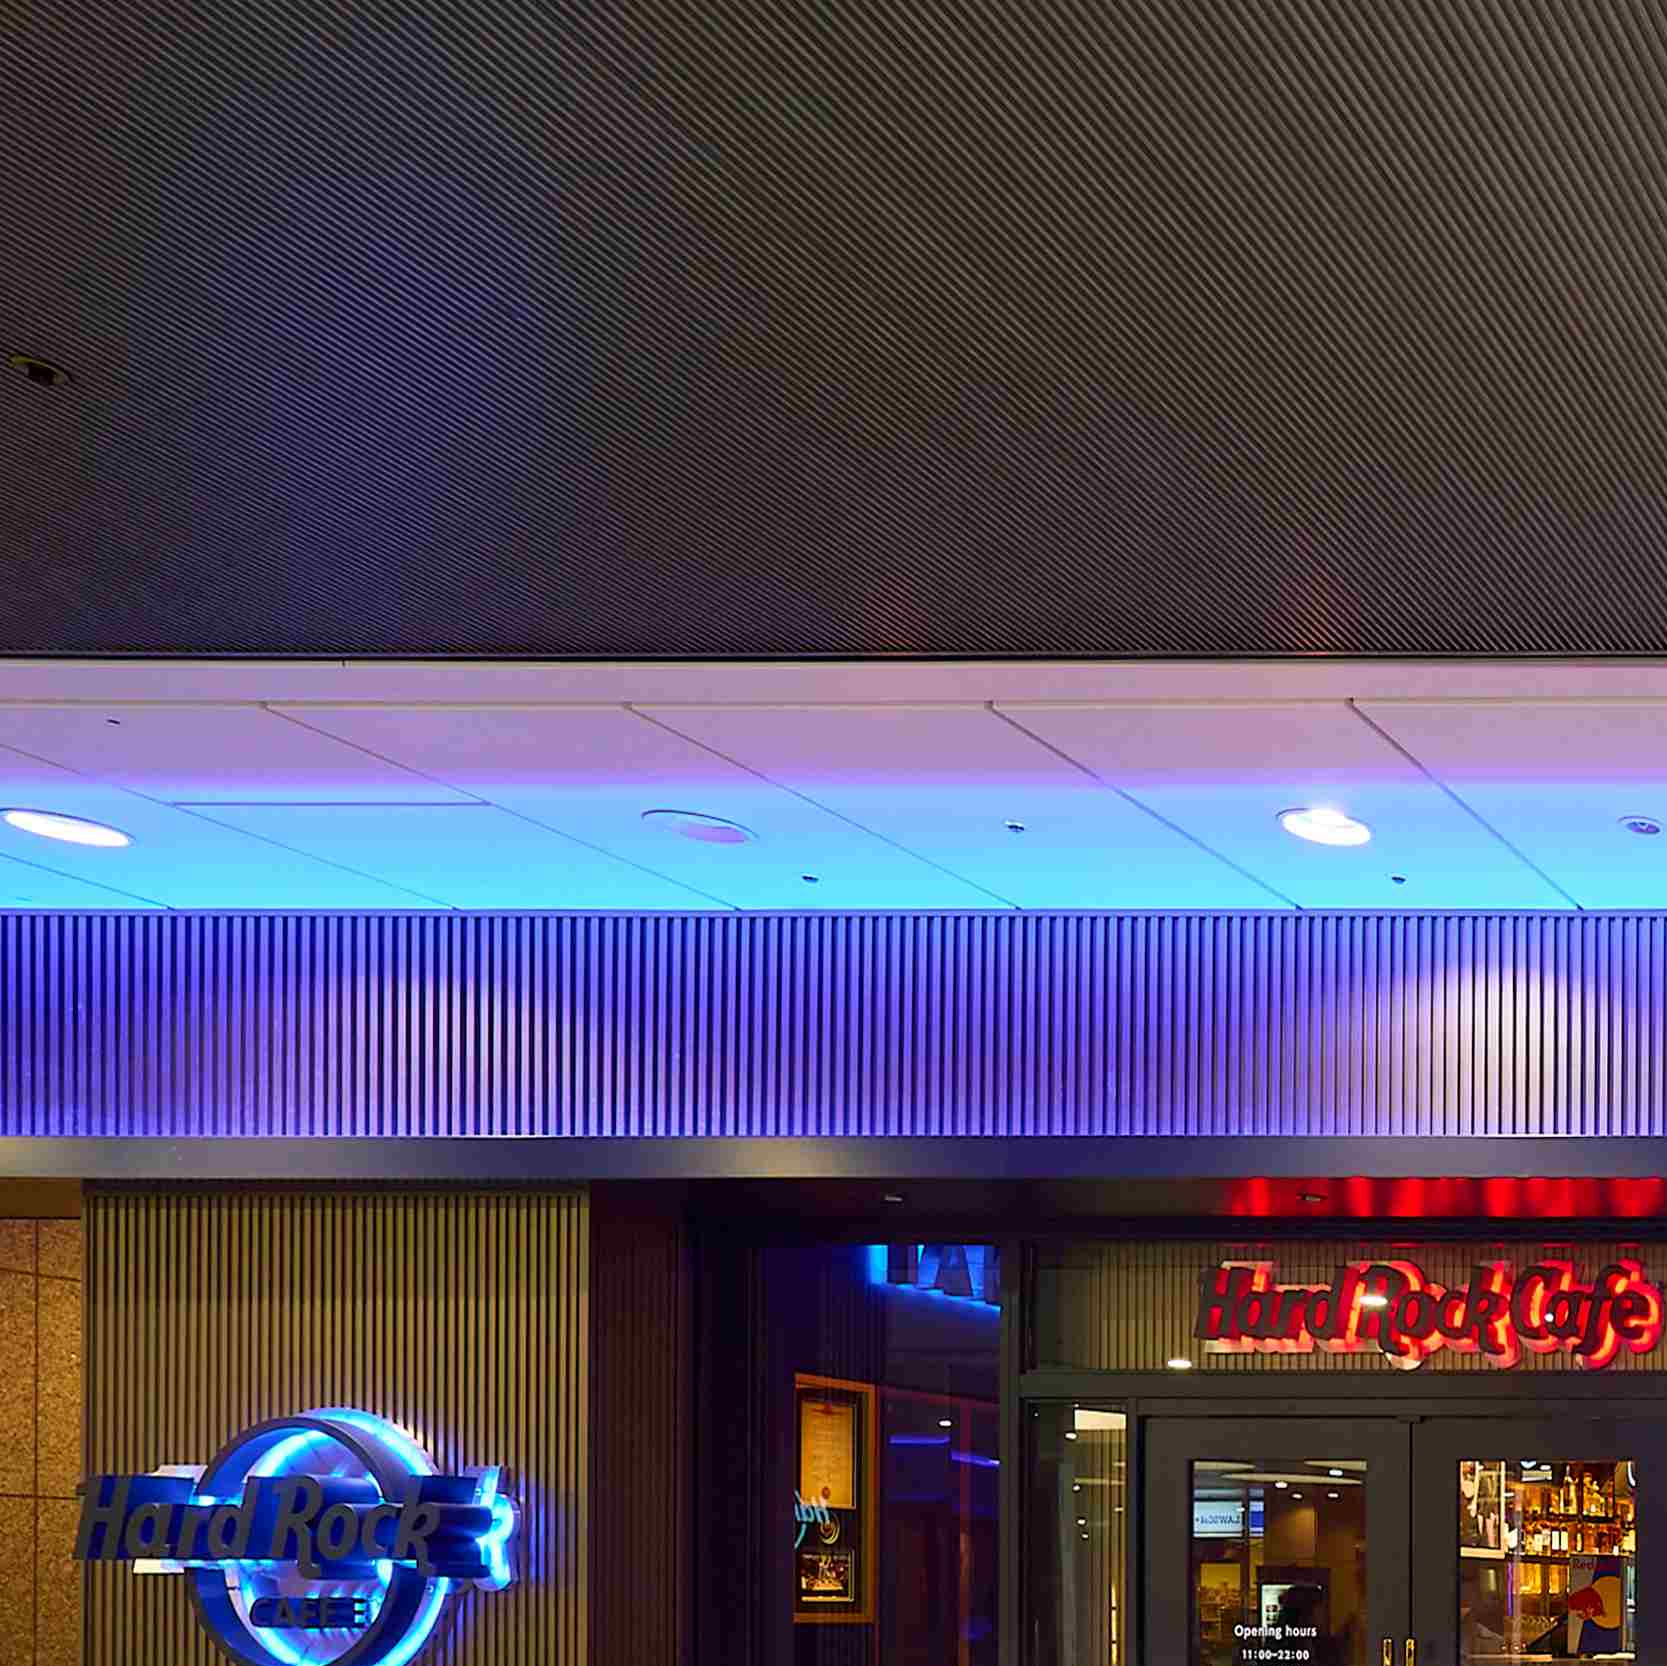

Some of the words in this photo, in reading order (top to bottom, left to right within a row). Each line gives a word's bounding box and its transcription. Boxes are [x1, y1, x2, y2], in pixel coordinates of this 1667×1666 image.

[1195, 1265, 1352, 1340] Hard
[1358, 1264, 1504, 1356] Rock
[74, 1474, 258, 1560] Hard
[275, 1474, 440, 1578] Rock
[1234, 1624, 1282, 1640] Opening
[1285, 1624, 1317, 1637] hours
[1242, 1649, 1310, 1660] 11:00-22:00
